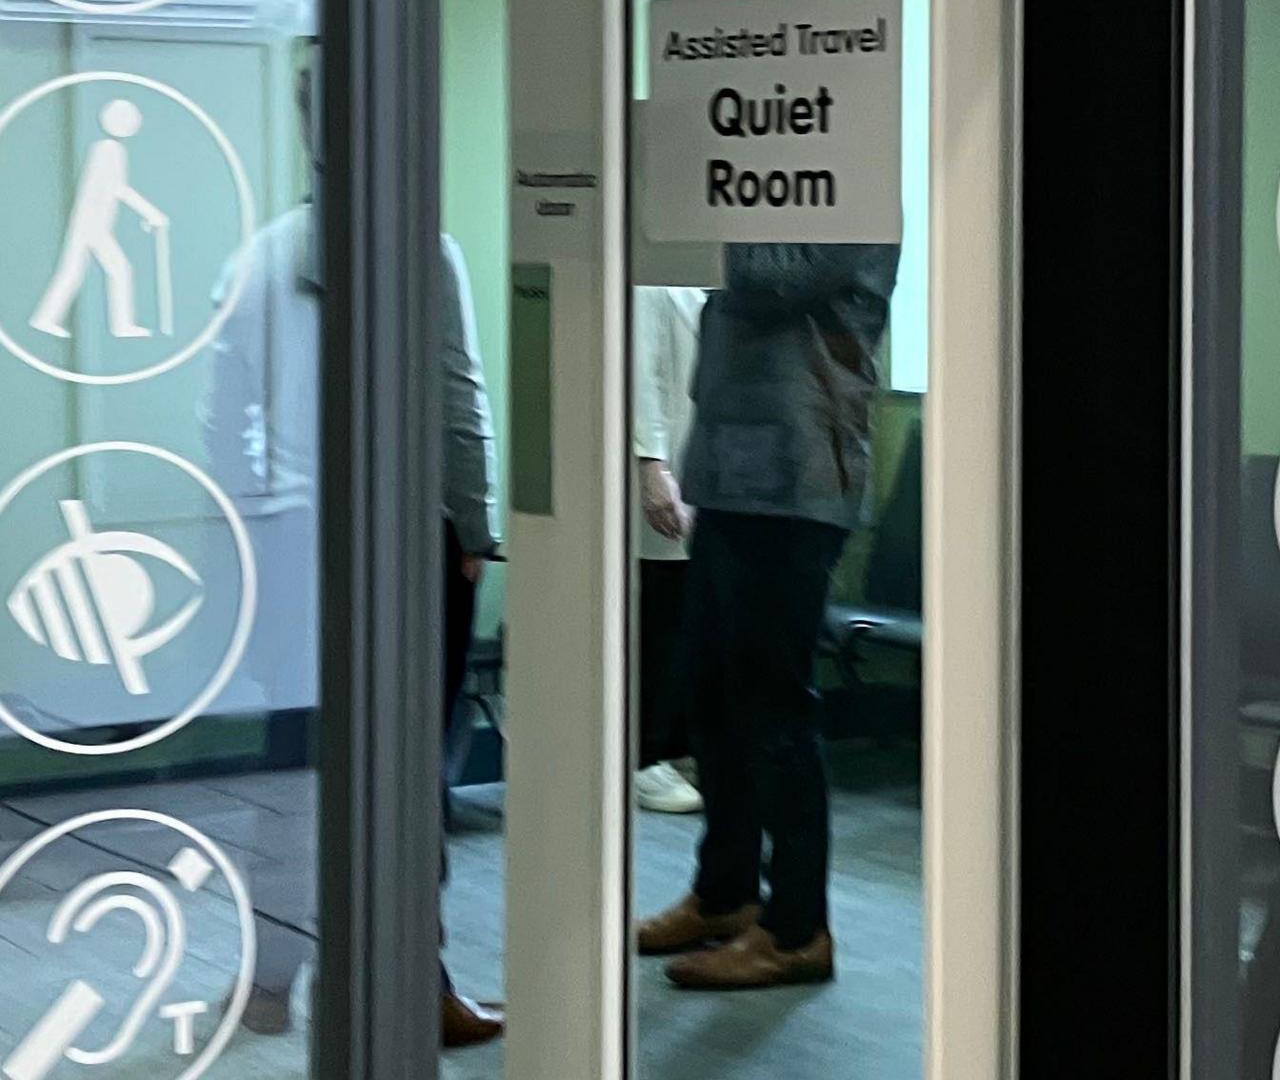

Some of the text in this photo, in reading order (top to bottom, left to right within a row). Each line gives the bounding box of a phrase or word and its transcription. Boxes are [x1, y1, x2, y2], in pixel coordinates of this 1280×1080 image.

[663, 17, 887, 62] Assisted Travel
[707, 83, 834, 138] Quiet
[705, 159, 837, 208] Room
